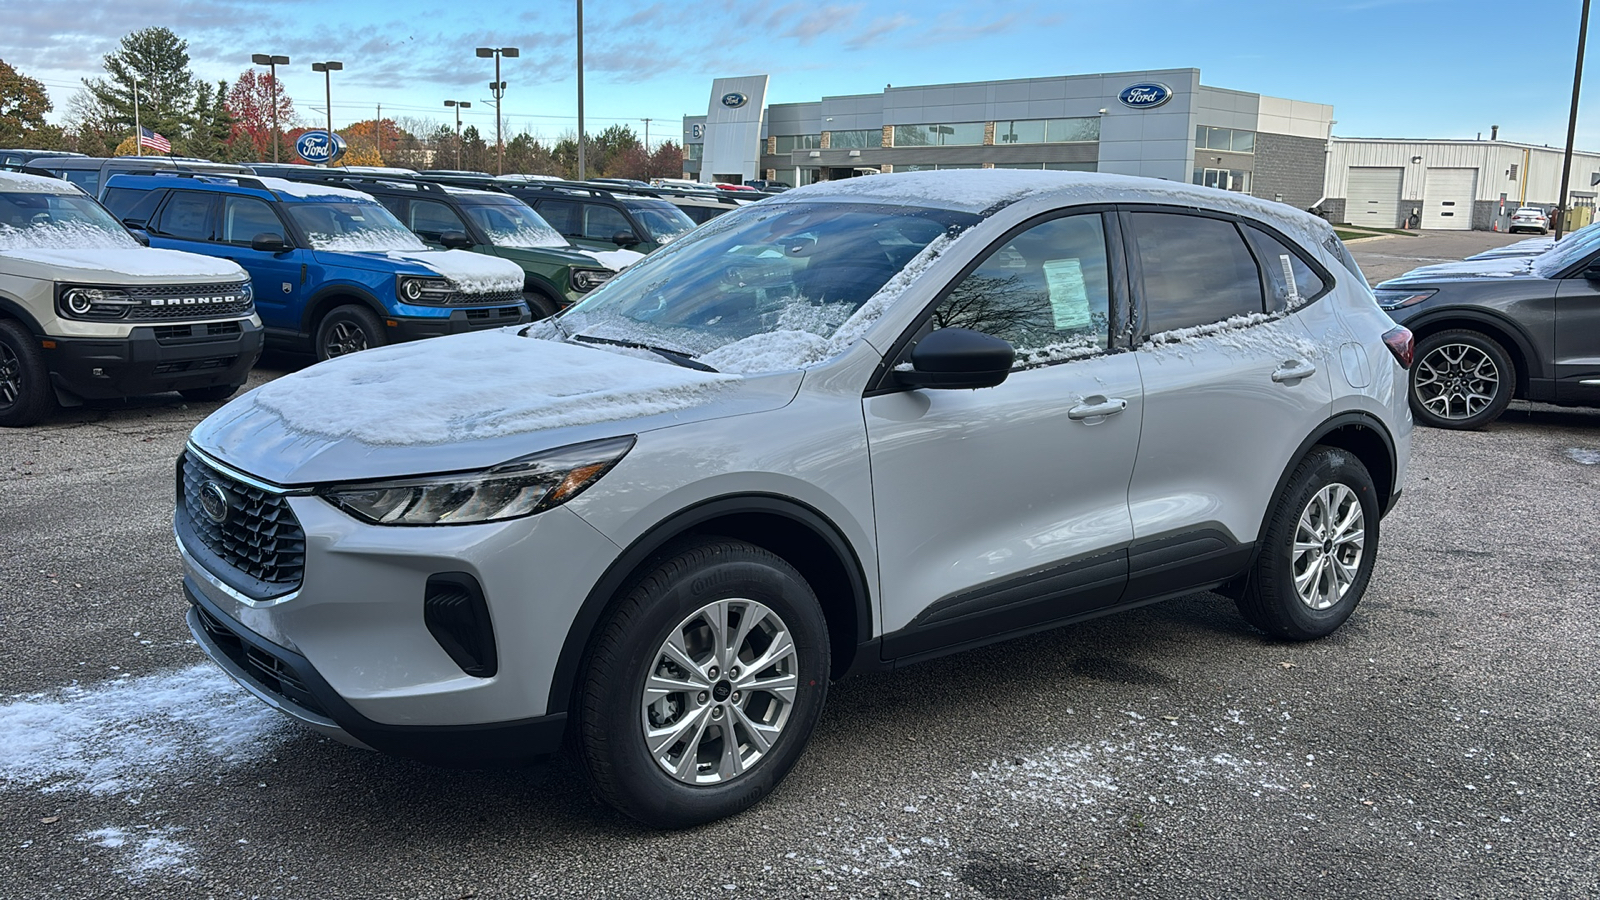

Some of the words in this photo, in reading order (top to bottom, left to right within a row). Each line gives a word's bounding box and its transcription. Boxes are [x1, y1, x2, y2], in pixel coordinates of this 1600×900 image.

[1128, 88, 1157, 102] Ford
[693, 124, 706, 139] B
[303, 137, 329, 156] Ford
[151, 296, 235, 306] BRONCO
